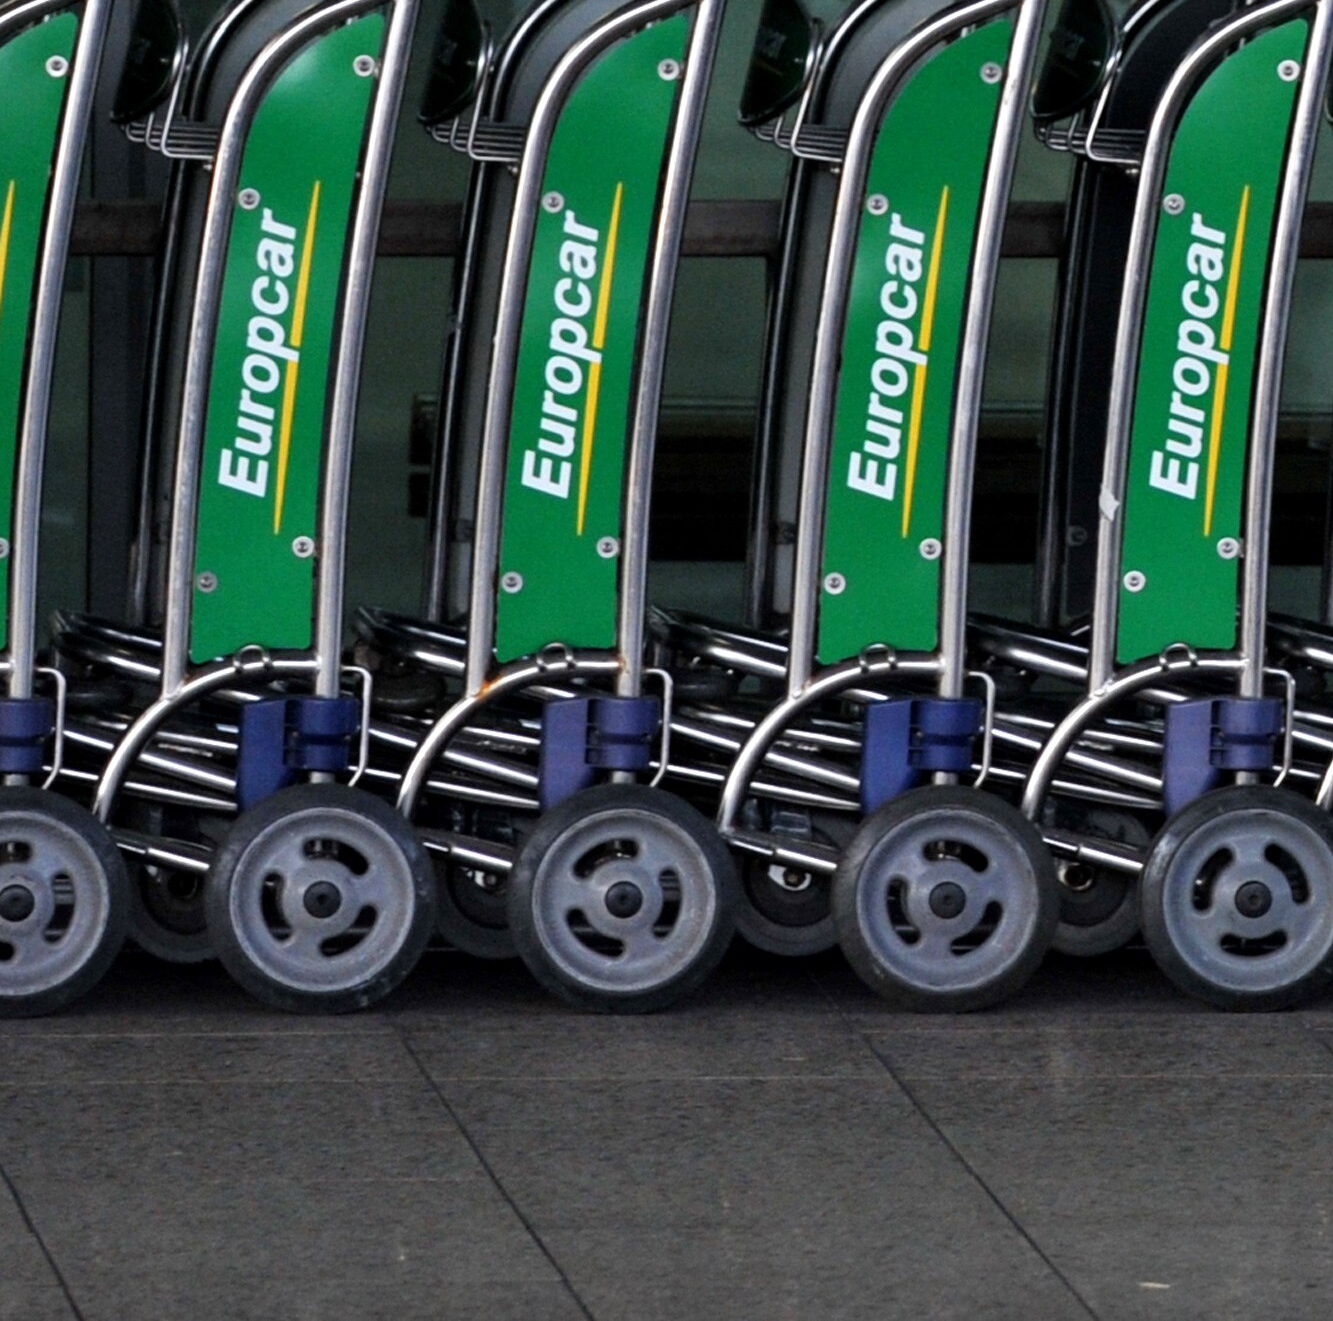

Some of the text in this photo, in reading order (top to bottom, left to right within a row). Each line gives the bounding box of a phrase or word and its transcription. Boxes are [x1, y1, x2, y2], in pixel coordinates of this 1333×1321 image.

[218, 207, 300, 498] Europcar
[522, 209, 603, 499] Europcar
[848, 212, 929, 501] Europcar
[1150, 212, 1230, 500] Europcar
